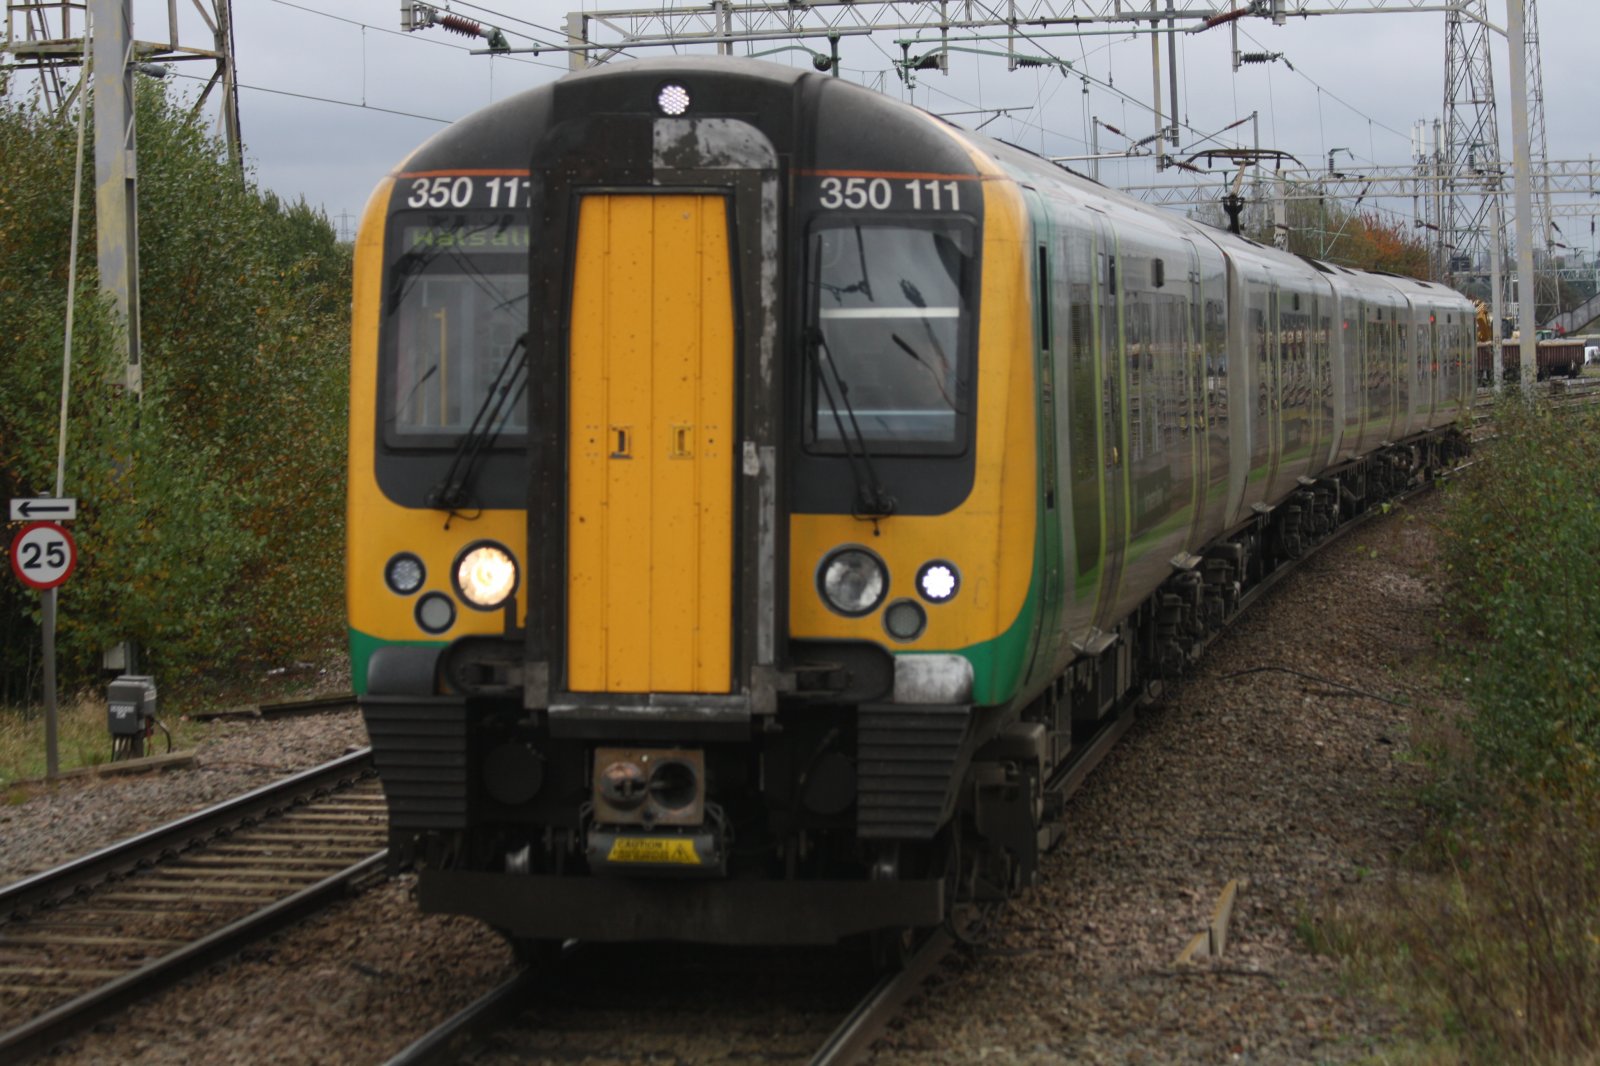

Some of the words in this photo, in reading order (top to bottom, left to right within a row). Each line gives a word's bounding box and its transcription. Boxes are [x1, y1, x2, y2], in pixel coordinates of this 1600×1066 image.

[408, 176, 473, 208] 350
[819, 177, 892, 210] 350
[905, 179, 960, 211] 111
[22, 541, 65, 569] 25
